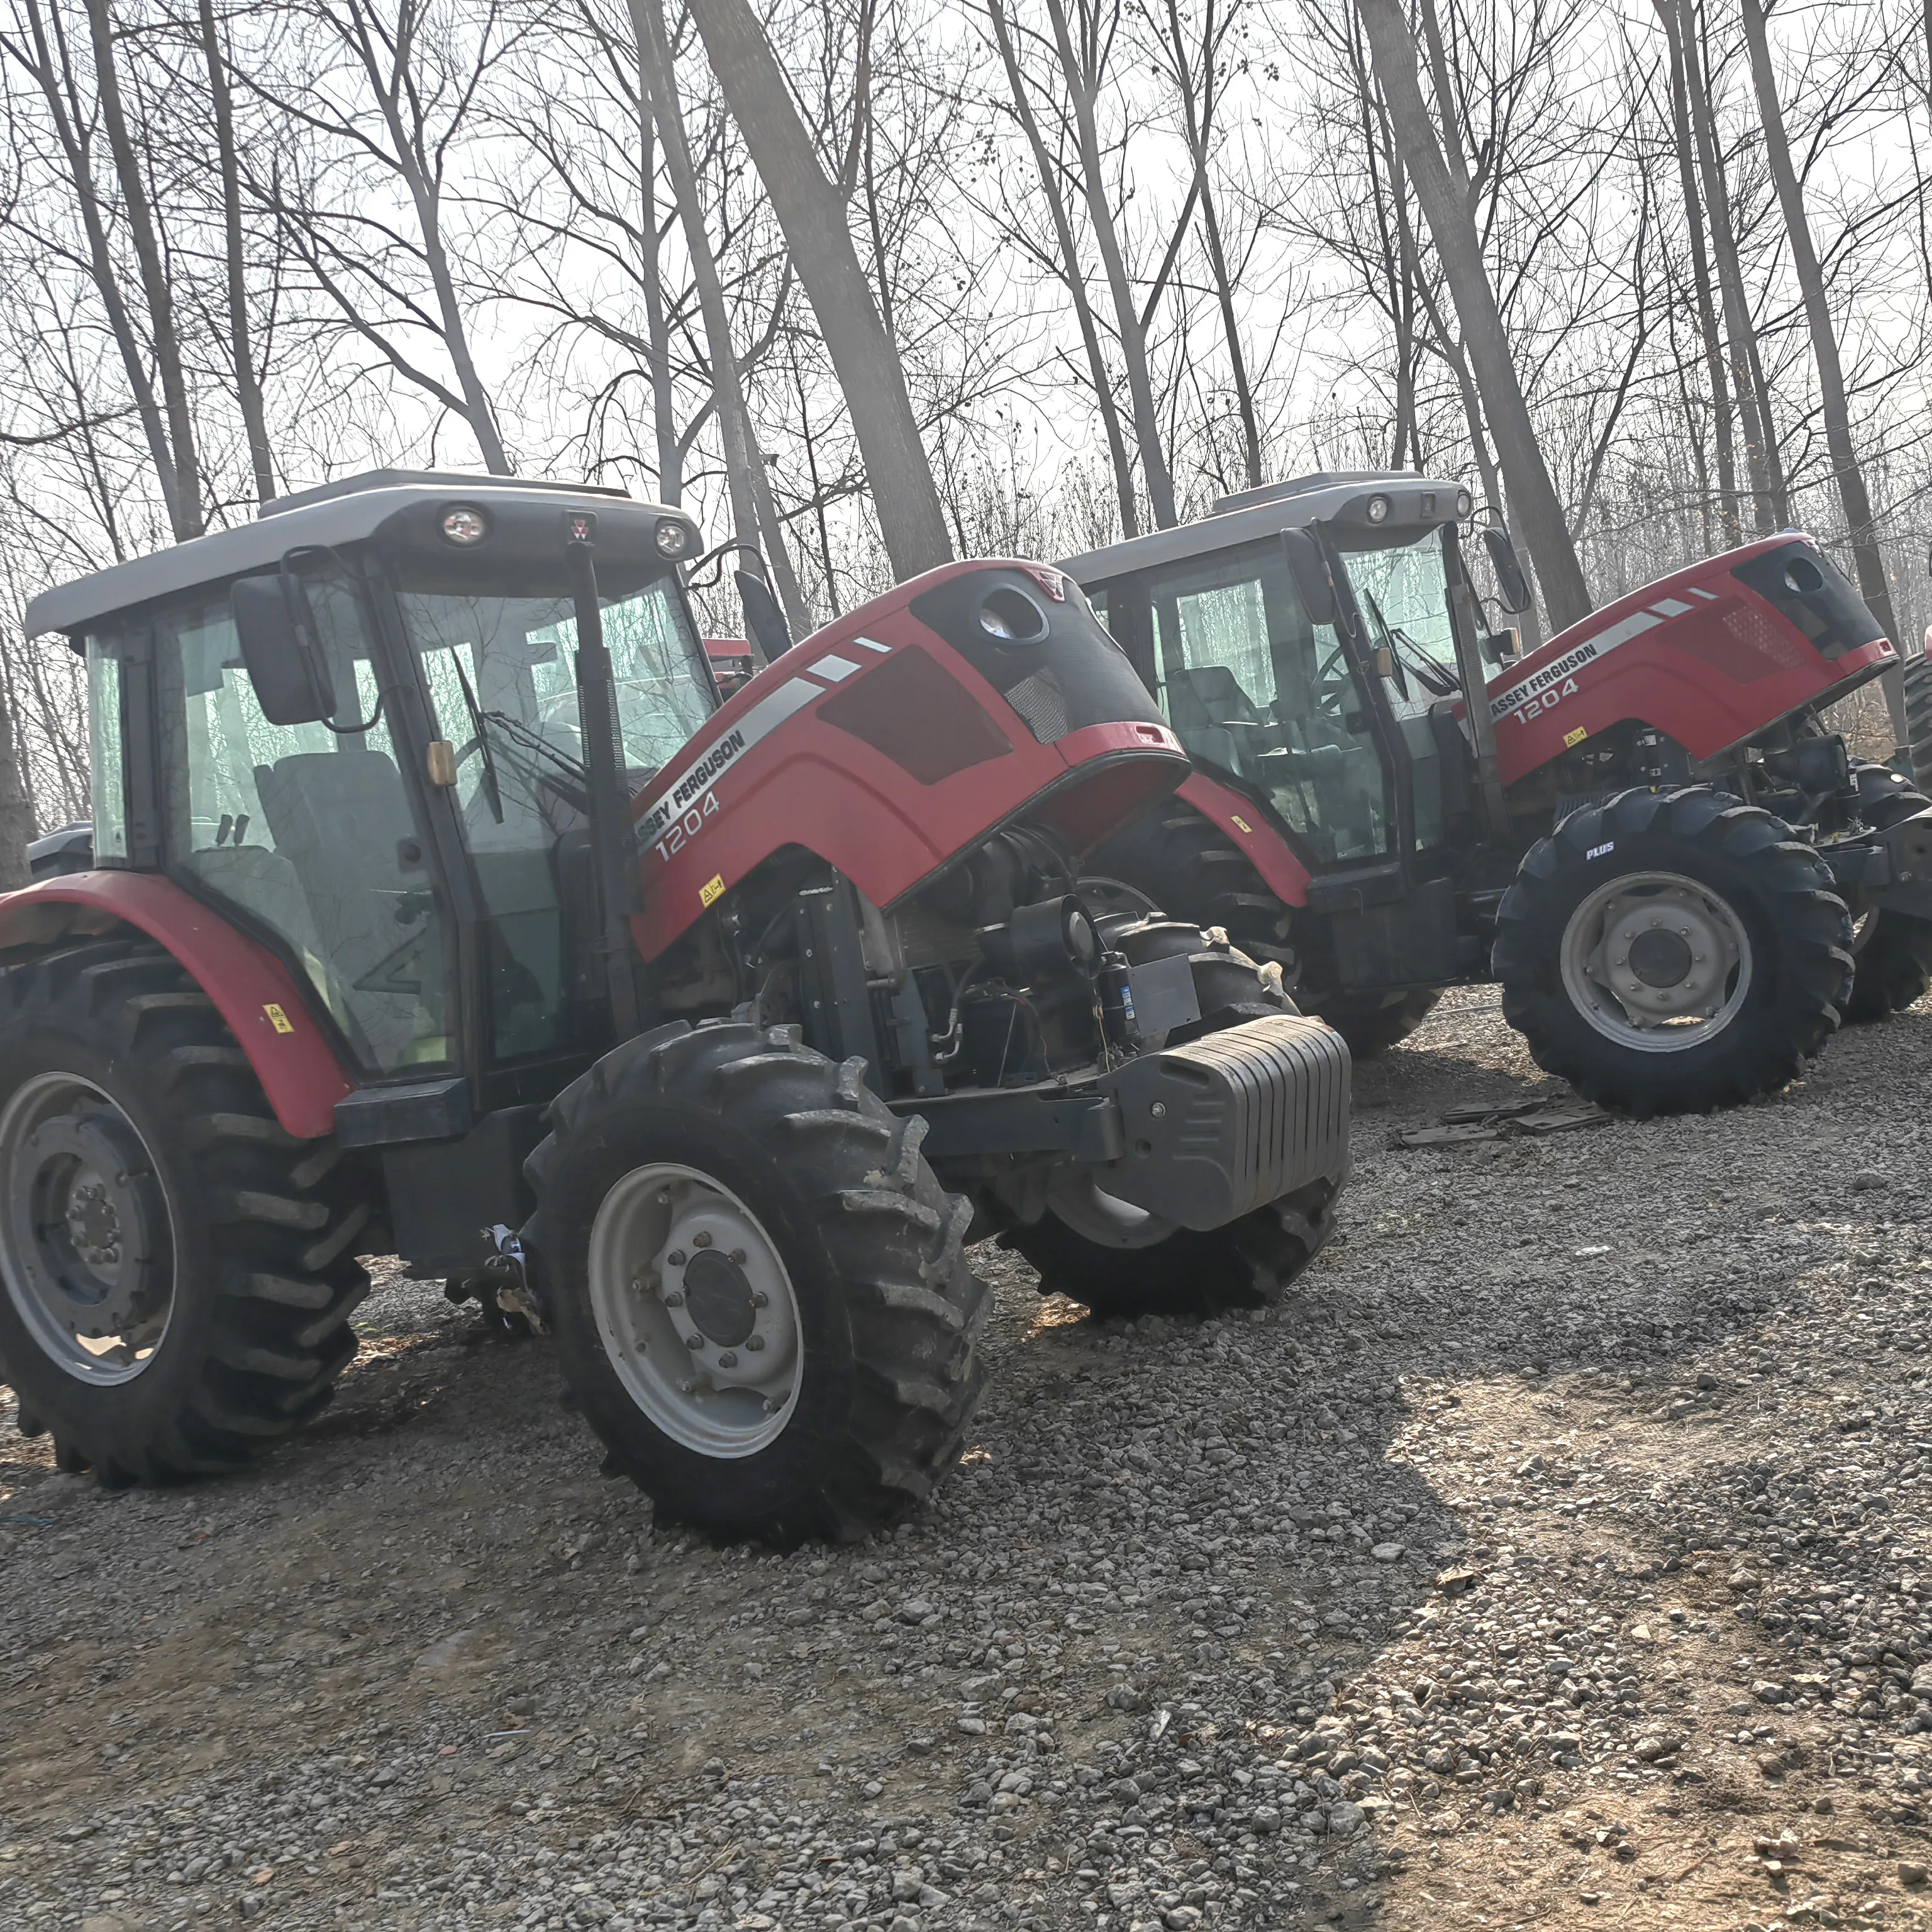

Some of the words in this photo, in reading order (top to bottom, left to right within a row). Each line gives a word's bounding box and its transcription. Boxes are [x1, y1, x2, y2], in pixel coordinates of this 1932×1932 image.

[1491, 684, 1530, 716] ASSEY
[1529, 643, 1597, 692] FERGUSON
[1513, 678, 1579, 724] 1204
[637, 801, 671, 843] SSEY
[672, 730, 745, 809] FERGUSON
[655, 791, 720, 862] 1204
[1586, 841, 1614, 860] PLUS
